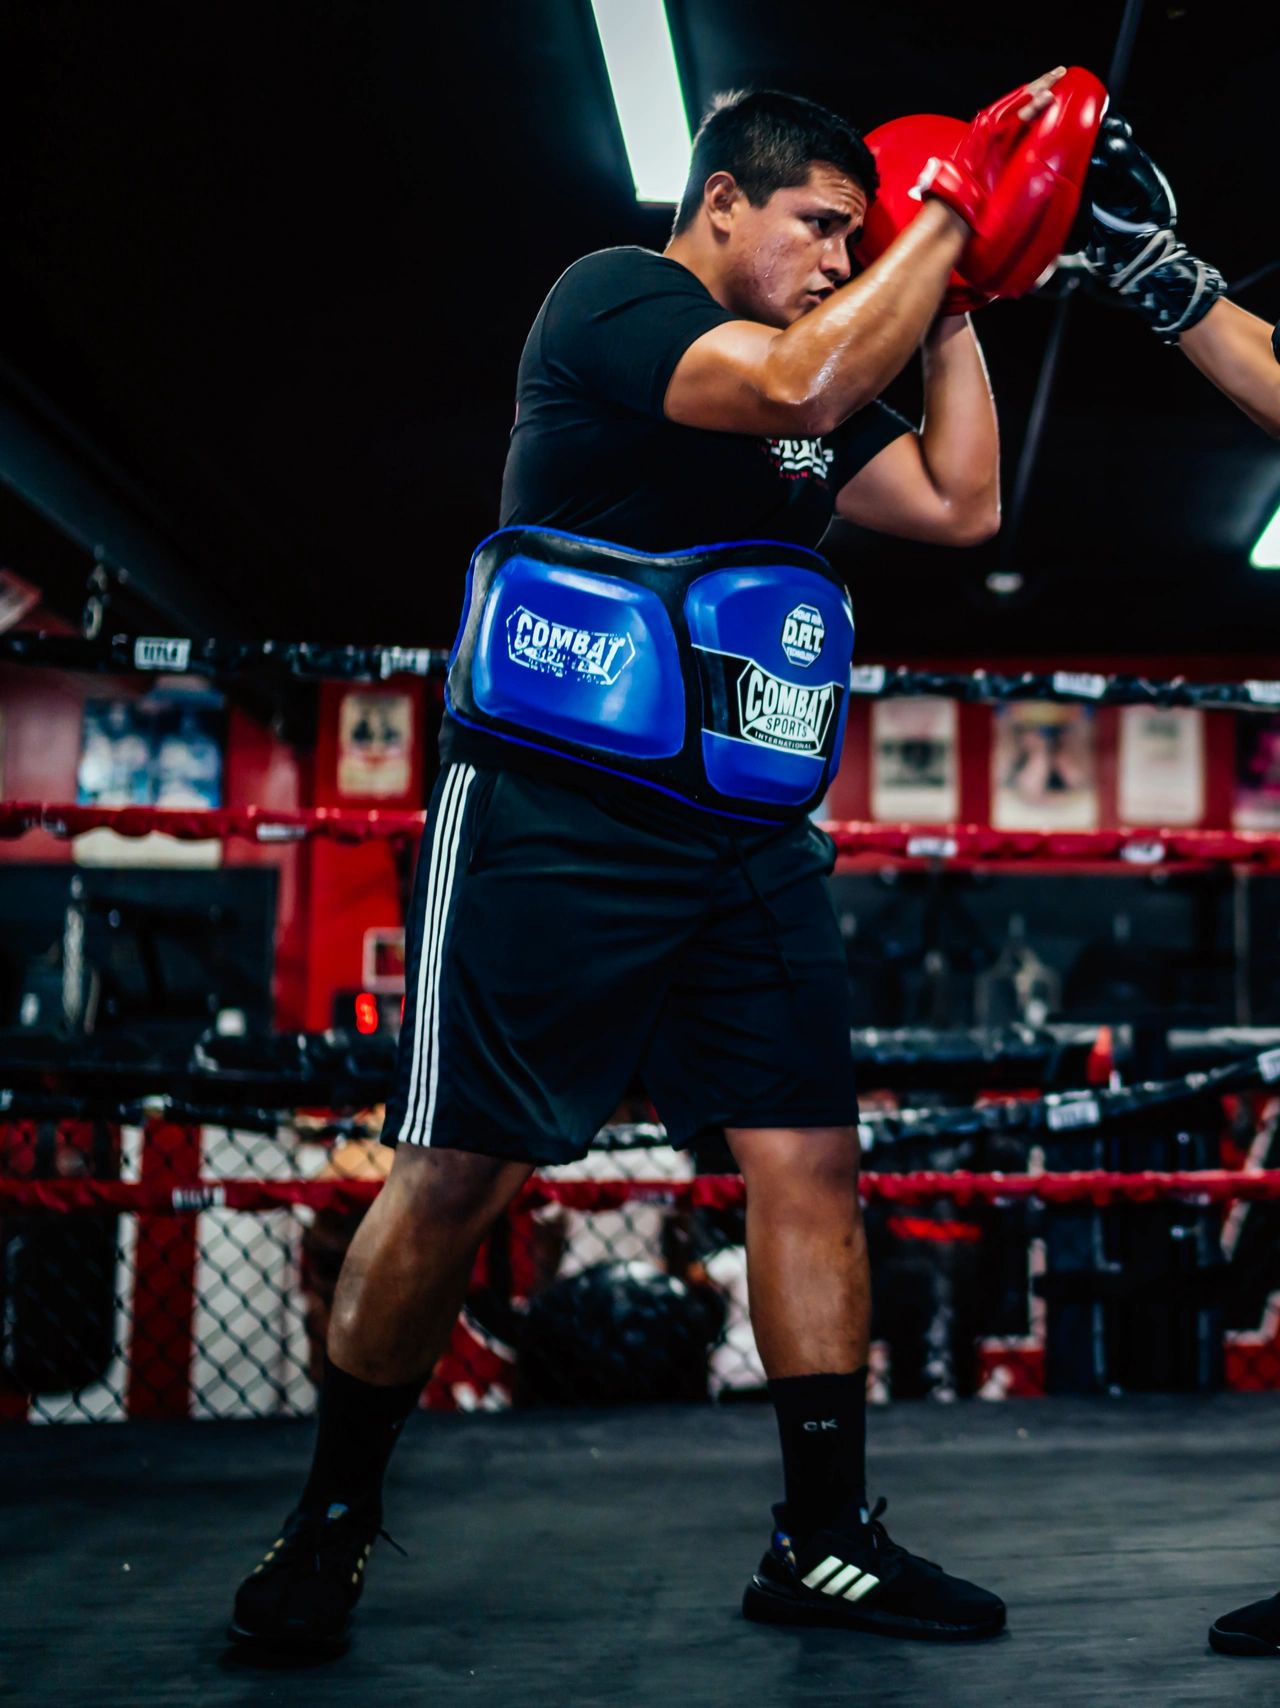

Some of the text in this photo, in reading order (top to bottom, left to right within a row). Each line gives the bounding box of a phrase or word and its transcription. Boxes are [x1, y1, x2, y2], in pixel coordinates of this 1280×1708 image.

[514, 613, 626, 674] COMBAT
[745, 669, 831, 737] COMBAT
[766, 717, 808, 738] SPORTS
[754, 730, 812, 750] INTERNATIONAL
[803, 1419, 838, 1431] CK
